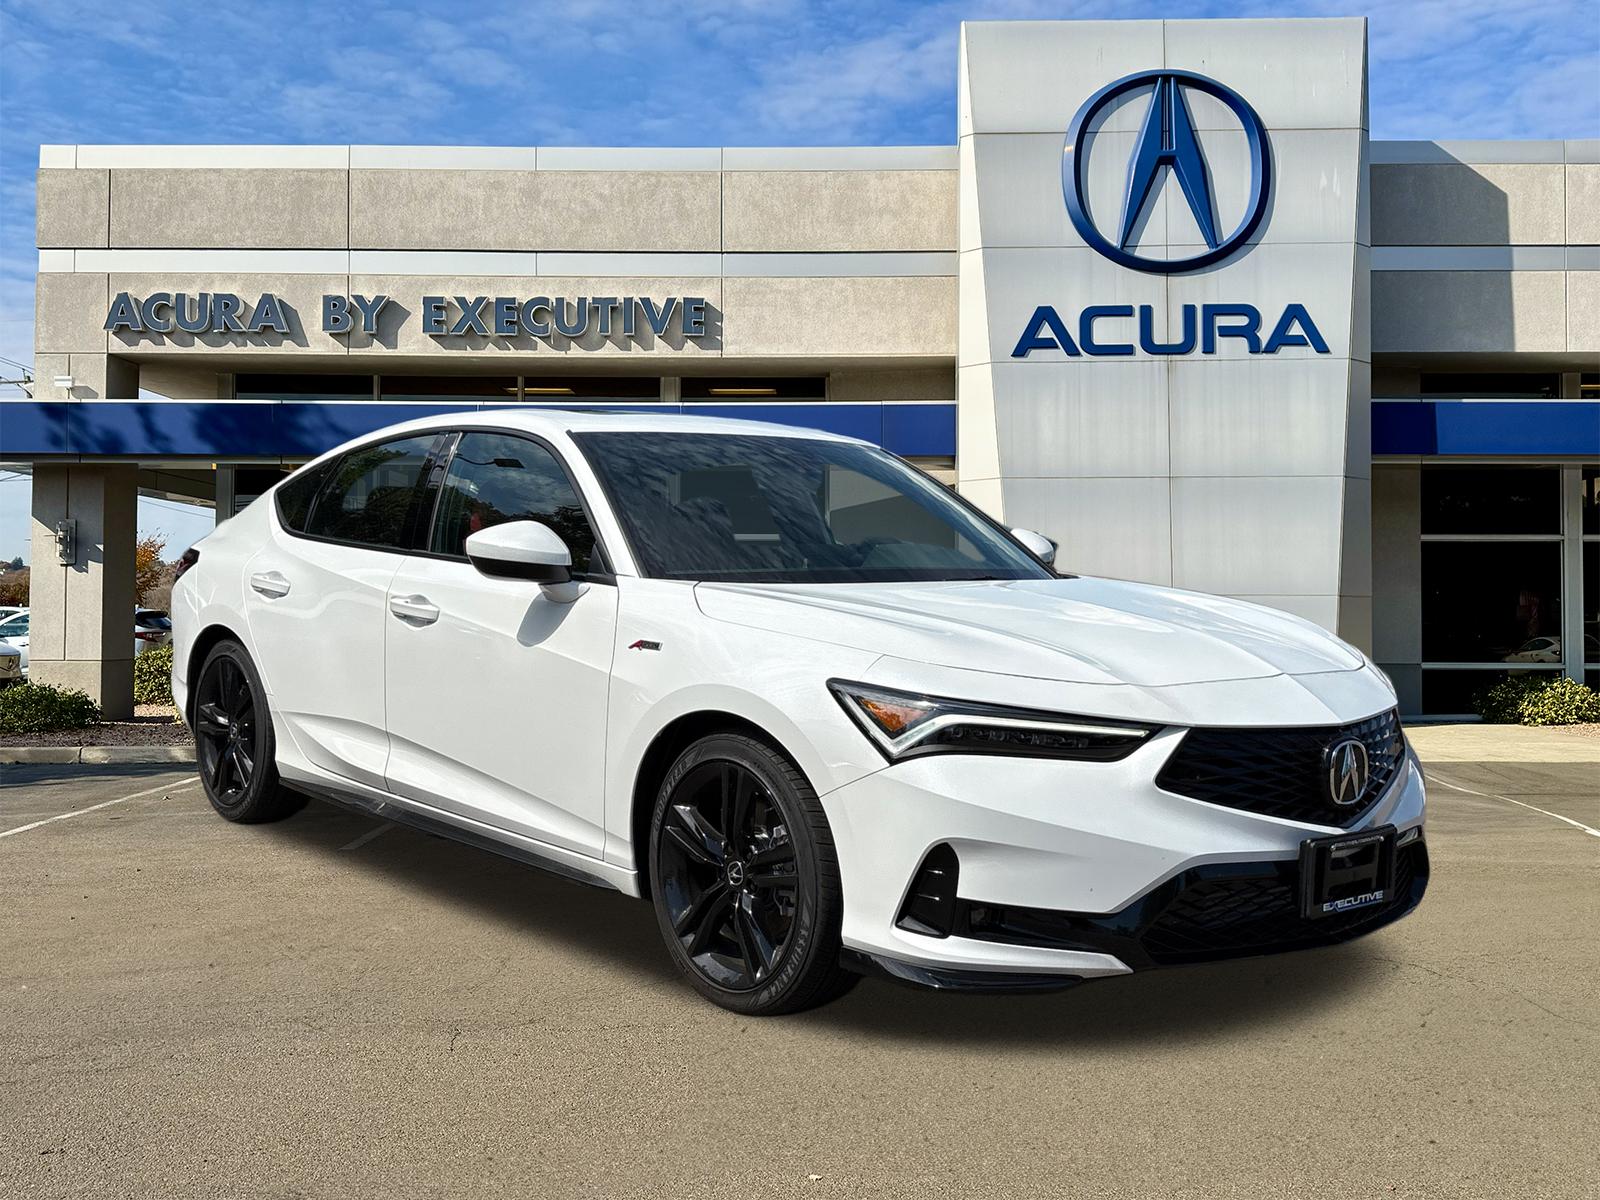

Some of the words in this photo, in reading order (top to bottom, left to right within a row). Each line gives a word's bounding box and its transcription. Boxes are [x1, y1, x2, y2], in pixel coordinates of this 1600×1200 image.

[103, 292, 290, 333] ACURA
[321, 294, 390, 335] BY
[422, 295, 707, 338] EXECUTIVE
[1010, 303, 1331, 358] ACURA
[1323, 890, 1384, 912] EXECUTIVE
